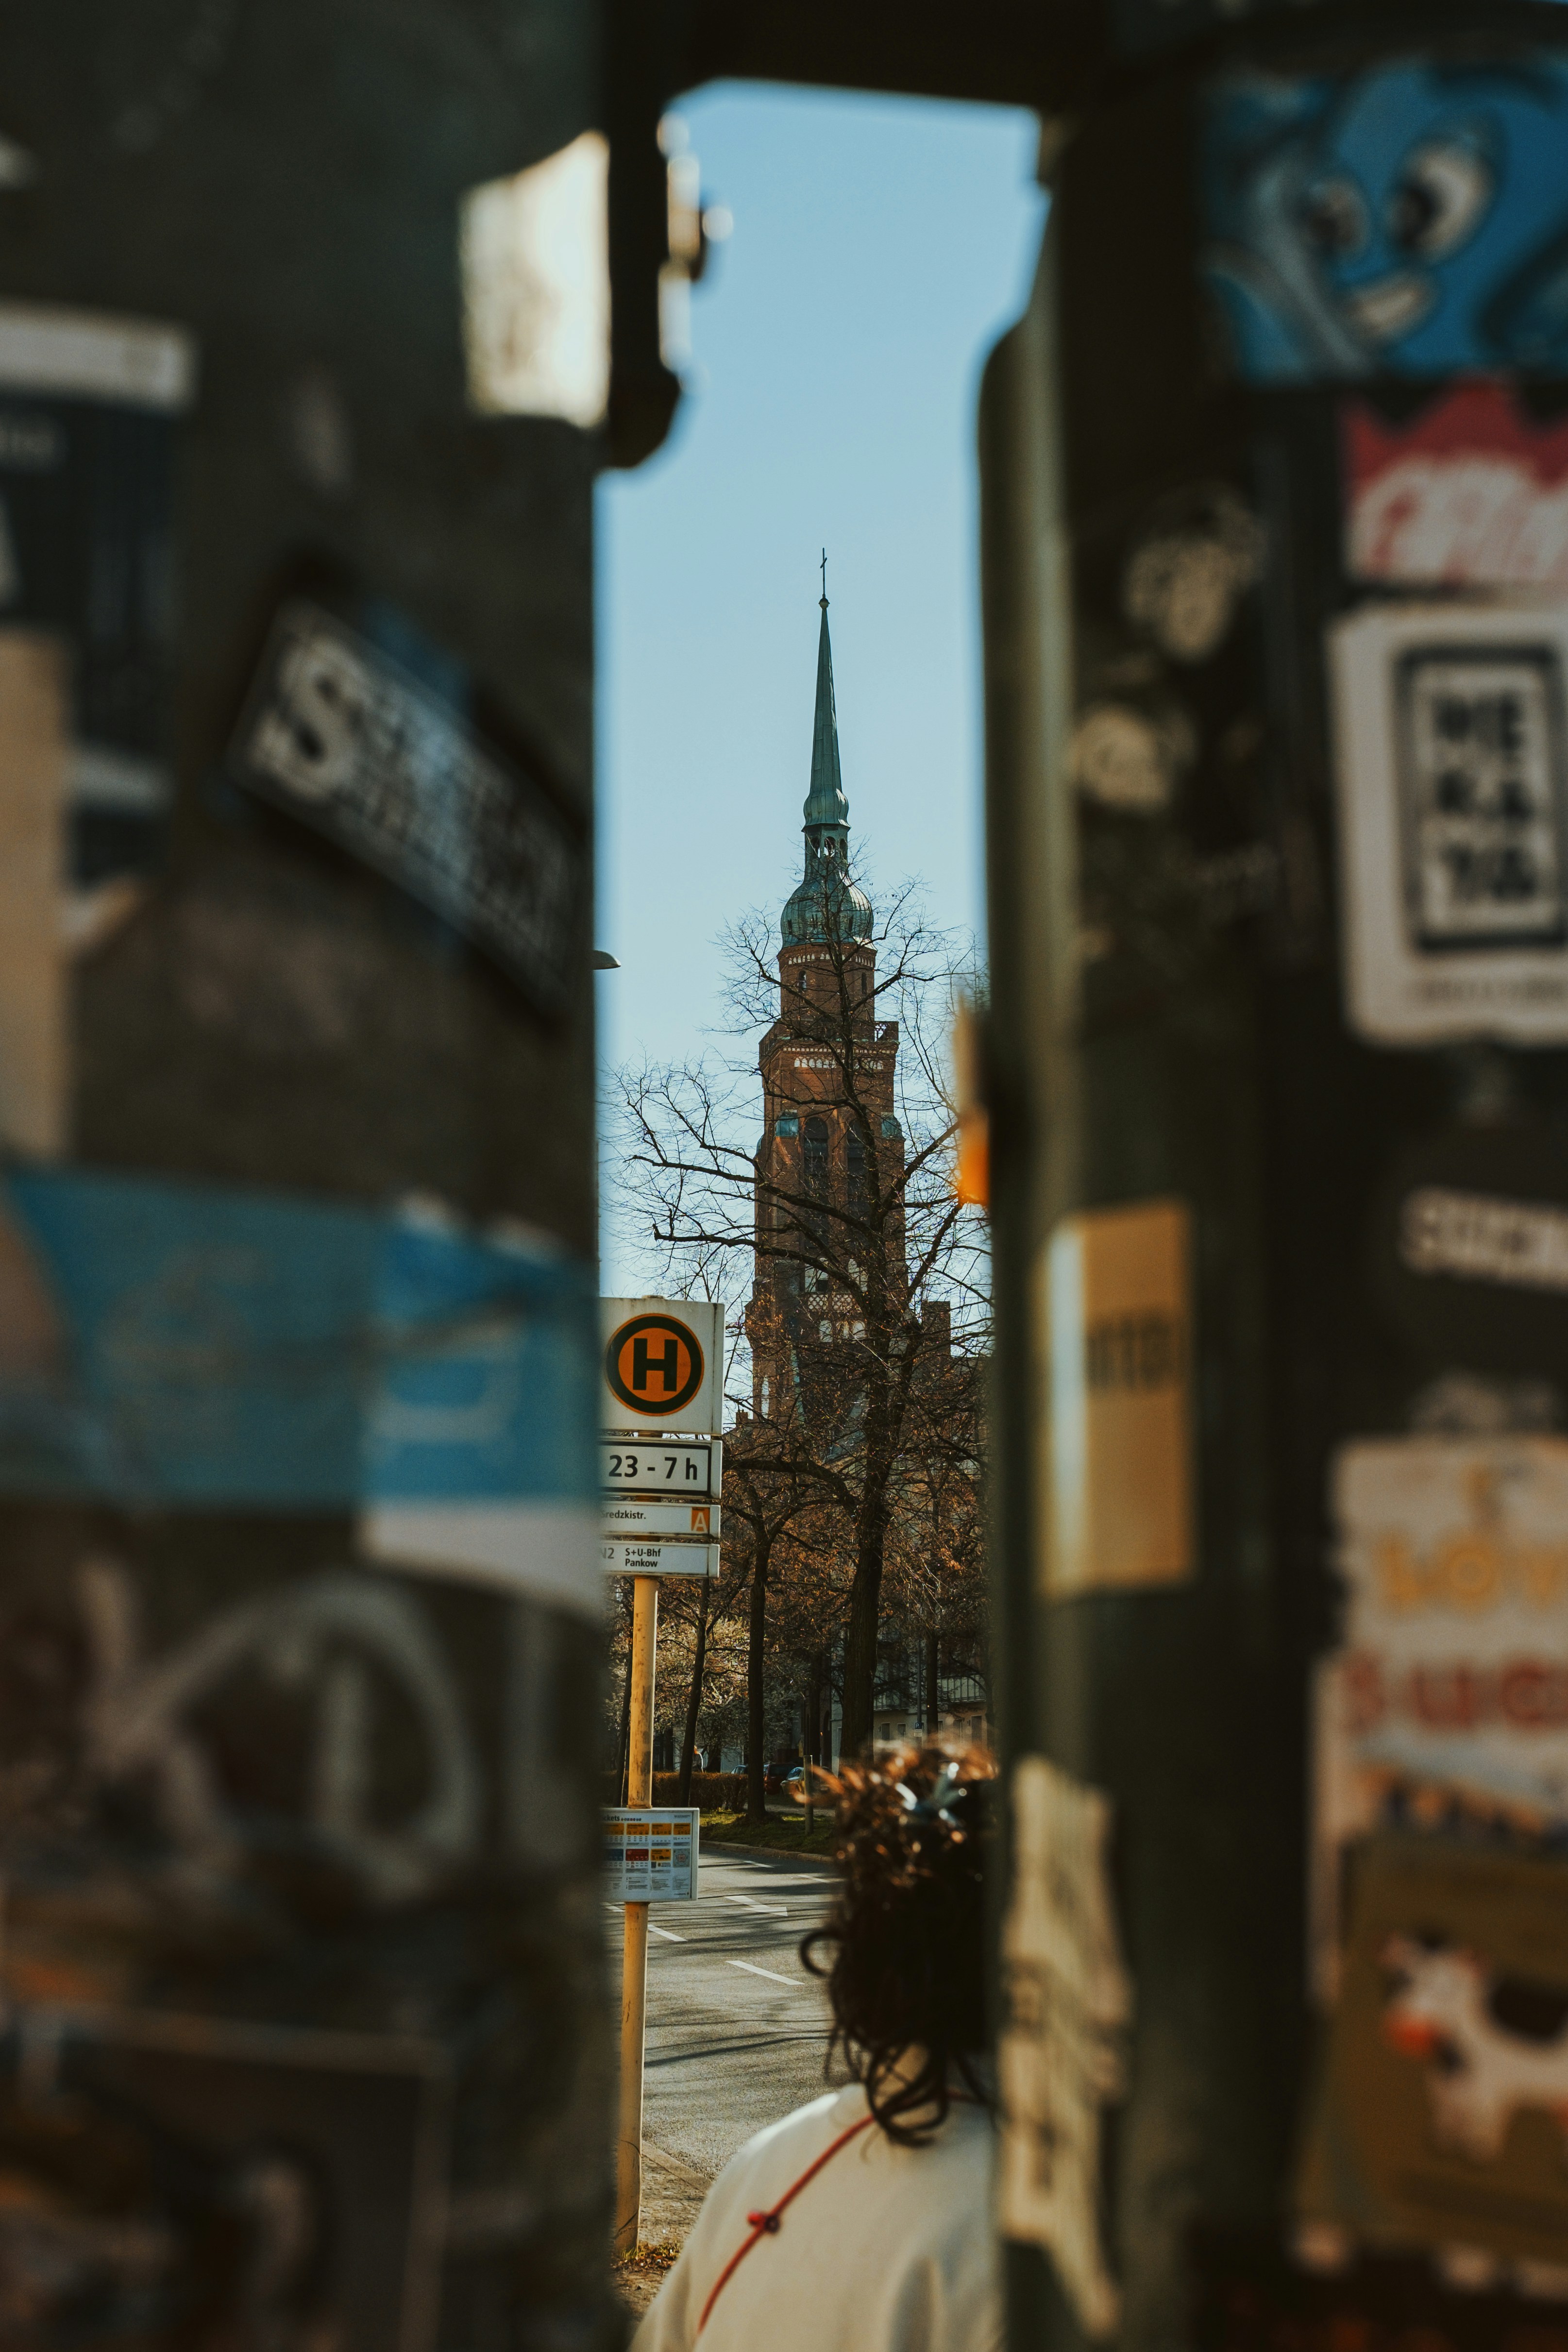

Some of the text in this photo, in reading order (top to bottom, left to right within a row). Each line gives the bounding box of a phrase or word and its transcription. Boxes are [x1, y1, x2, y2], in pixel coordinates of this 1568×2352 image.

[633, 1338, 678, 1392] H
[608, 1455, 638, 1477] 23
[664, 1456, 677, 1479] 7
[685, 1457, 697, 1480] h
[693, 1512, 708, 1533] A
[625, 1548, 661, 1557] S+U-Bhf
[625, 1558, 658, 1567] Pankow
